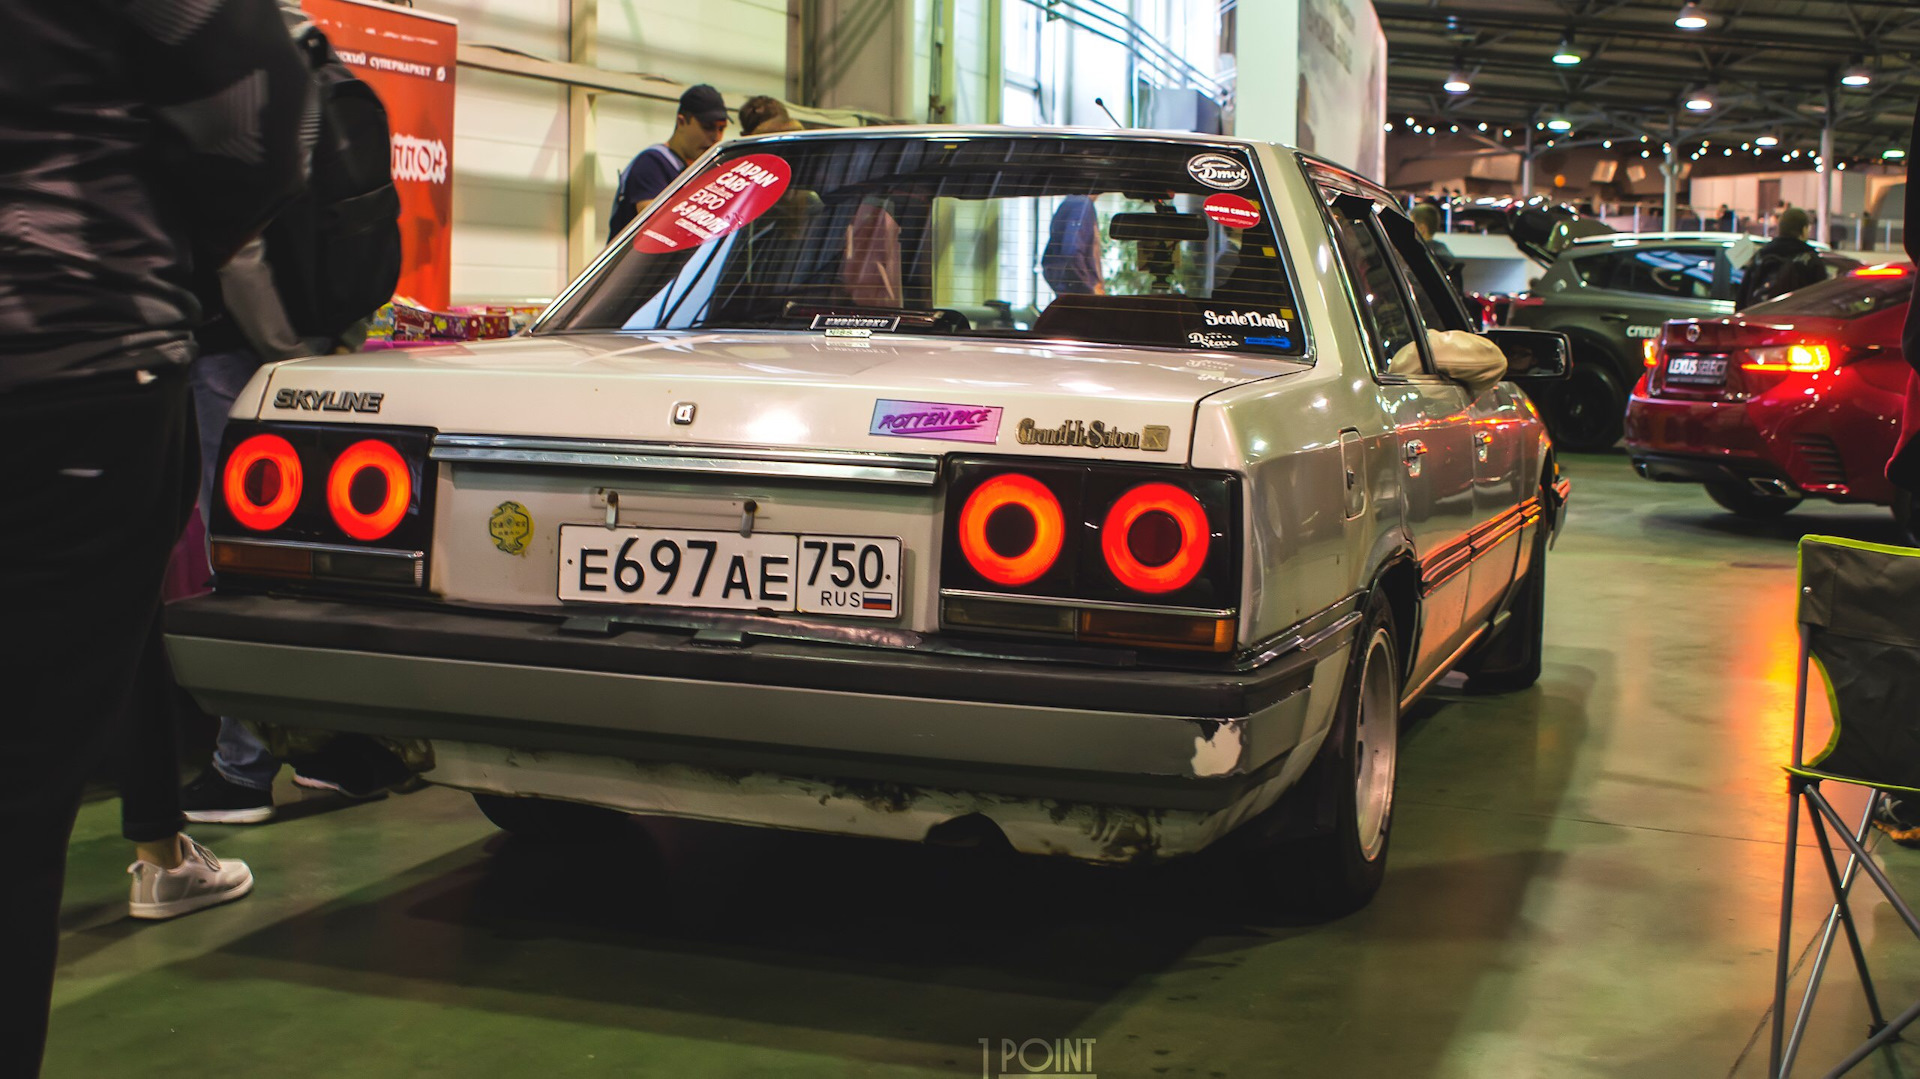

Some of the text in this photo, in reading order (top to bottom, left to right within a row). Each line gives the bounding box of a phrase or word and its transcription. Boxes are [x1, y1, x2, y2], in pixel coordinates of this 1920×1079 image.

[369, 56, 431, 76] СУПЕРМАРКЕТ
[715, 172, 751, 193] CARS
[730, 160, 779, 188] JAPAN
[688, 188, 726, 210] EXPO
[1204, 204, 1251, 217] JAPAN CARS
[1667, 358, 1698, 375] LEXUS
[273, 387, 385, 414] SKYLINE
[878, 409, 992, 429] ROTTEN RICE
[803, 541, 886, 589] 750
[820, 591, 861, 608] RUS
